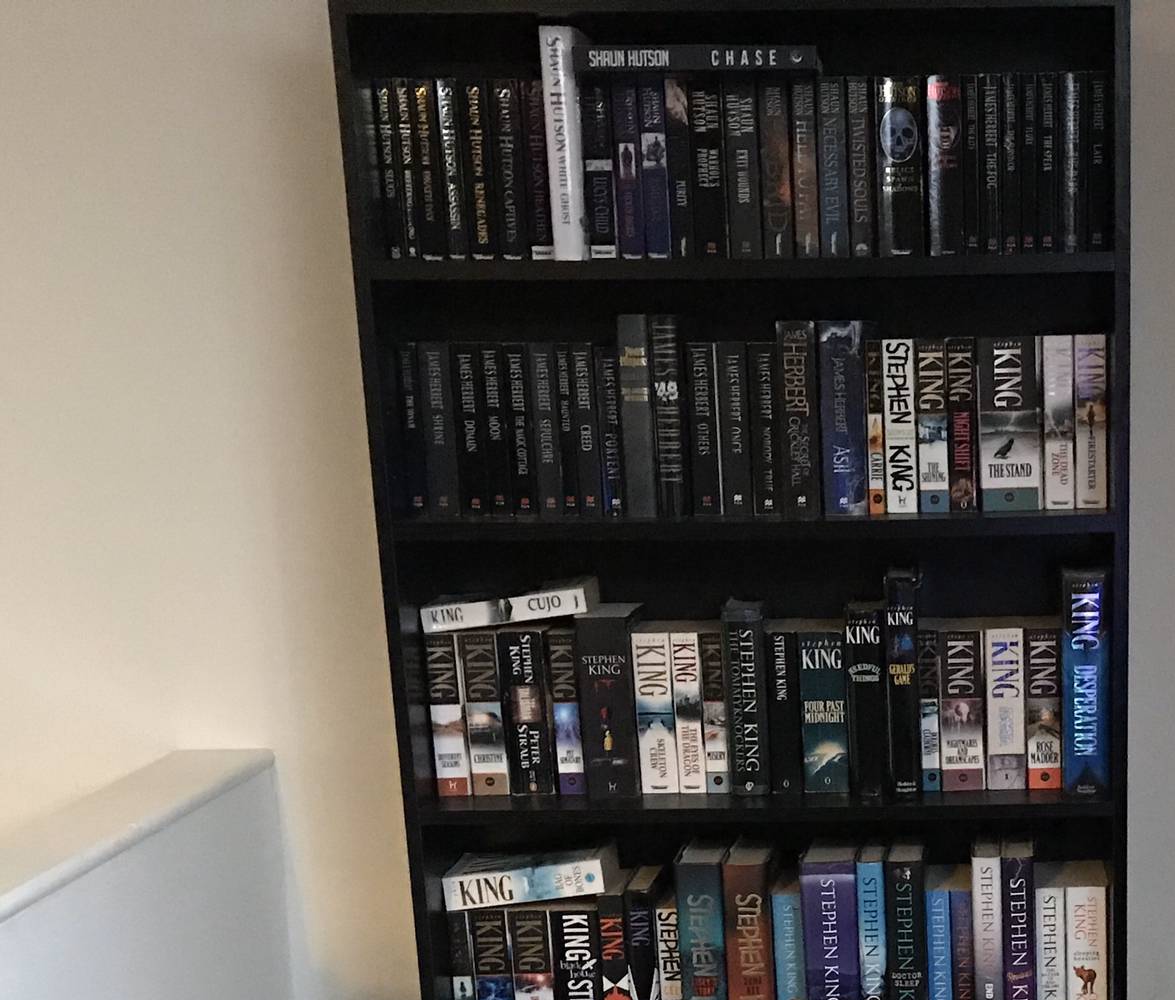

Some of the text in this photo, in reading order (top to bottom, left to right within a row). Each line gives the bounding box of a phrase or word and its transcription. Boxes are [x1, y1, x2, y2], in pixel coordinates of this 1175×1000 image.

[545, 36, 561, 87] SHAUN
[588, 49, 670, 68] SHAUN HUTSON
[710, 49, 777, 67] CHASE
[494, 87, 517, 192] SHAUN HUTSON
[550, 91, 568, 152] HUTSON
[739, 97, 754, 134] SHAUN
[466, 85, 490, 244] SHAUN HUTSON RENEGADES
[735, 149, 751, 204] EXIT WOUNDS
[823, 117, 840, 224] NECESSARY EVIL
[852, 118, 868, 223] TWISTED SOULS
[782, 343, 810, 417] HERBERT
[918, 351, 945, 410] KING
[948, 352, 973, 402] KING
[993, 348, 1022, 409] KING
[1078, 348, 1106, 396] KING
[488, 415, 502, 441] MOON
[580, 424, 593, 452] CREED
[697, 422, 710, 456] OTHERS
[885, 342, 914, 492] STEPHEN KING
[791, 463, 802, 487] HALL
[832, 445, 850, 473] ASH
[988, 463, 1033, 478] THE STAND
[430, 607, 463, 624] KING
[528, 594, 562, 612] CUJO
[887, 611, 914, 626] KING
[508, 644, 522, 676] KING
[519, 634, 534, 685] STEPHEN
[581, 655, 626, 664] STEPHEN
[801, 649, 842, 670] KING
[846, 625, 881, 644] KING
[426, 644, 456, 699] KING
[465, 643, 498, 700] KING
[550, 643, 577, 699] KING
[588, 664, 622, 676] KING
[636, 644, 668, 697] KING
[673, 643, 698, 682] KING
[702, 638, 723, 701] KING
[773, 634, 788, 701] STEPHEN KING
[893, 675, 913, 686] GAME
[947, 640, 976, 696] KING
[991, 640, 1020, 698] KING
[1029, 640, 1058, 695] KING
[1071, 592, 1101, 757] KING DESPERATION
[739, 628, 761, 773] STEPHEN KING
[804, 700, 845, 711] FOUR PAST
[804, 711, 845, 723] MIDNIGHT
[517, 723, 530, 769] STRAUB
[528, 729, 541, 764] PETER
[1031, 753, 1059, 764] MADDER
[1036, 740, 1053, 752] ROSE
[458, 875, 514, 906] KING
[981, 866, 994, 933] STEPHEN
[562, 913, 592, 963] KING
[600, 916, 625, 961] KING
[630, 909, 650, 947] KING
[686, 893, 720, 977] STEPHEN
[735, 893, 766, 976] STEPHEN
[820, 879, 839, 960] STEPHEN
[863, 877, 879, 957] STEPHEN
[895, 881, 914, 971] STEPHEN
[932, 897, 946, 970] STEPHEN
[1009, 878, 1028, 967] STEPHEN
[1043, 895, 1057, 968] STEPHEN
[1074, 904, 1087, 941] KING
[475, 919, 506, 971] KING
[515, 919, 546, 971] KING
[658, 910, 682, 981] STEPHEN
[783, 904, 800, 994] STEPHEN KING
[891, 971, 922, 980] DOCTOR
